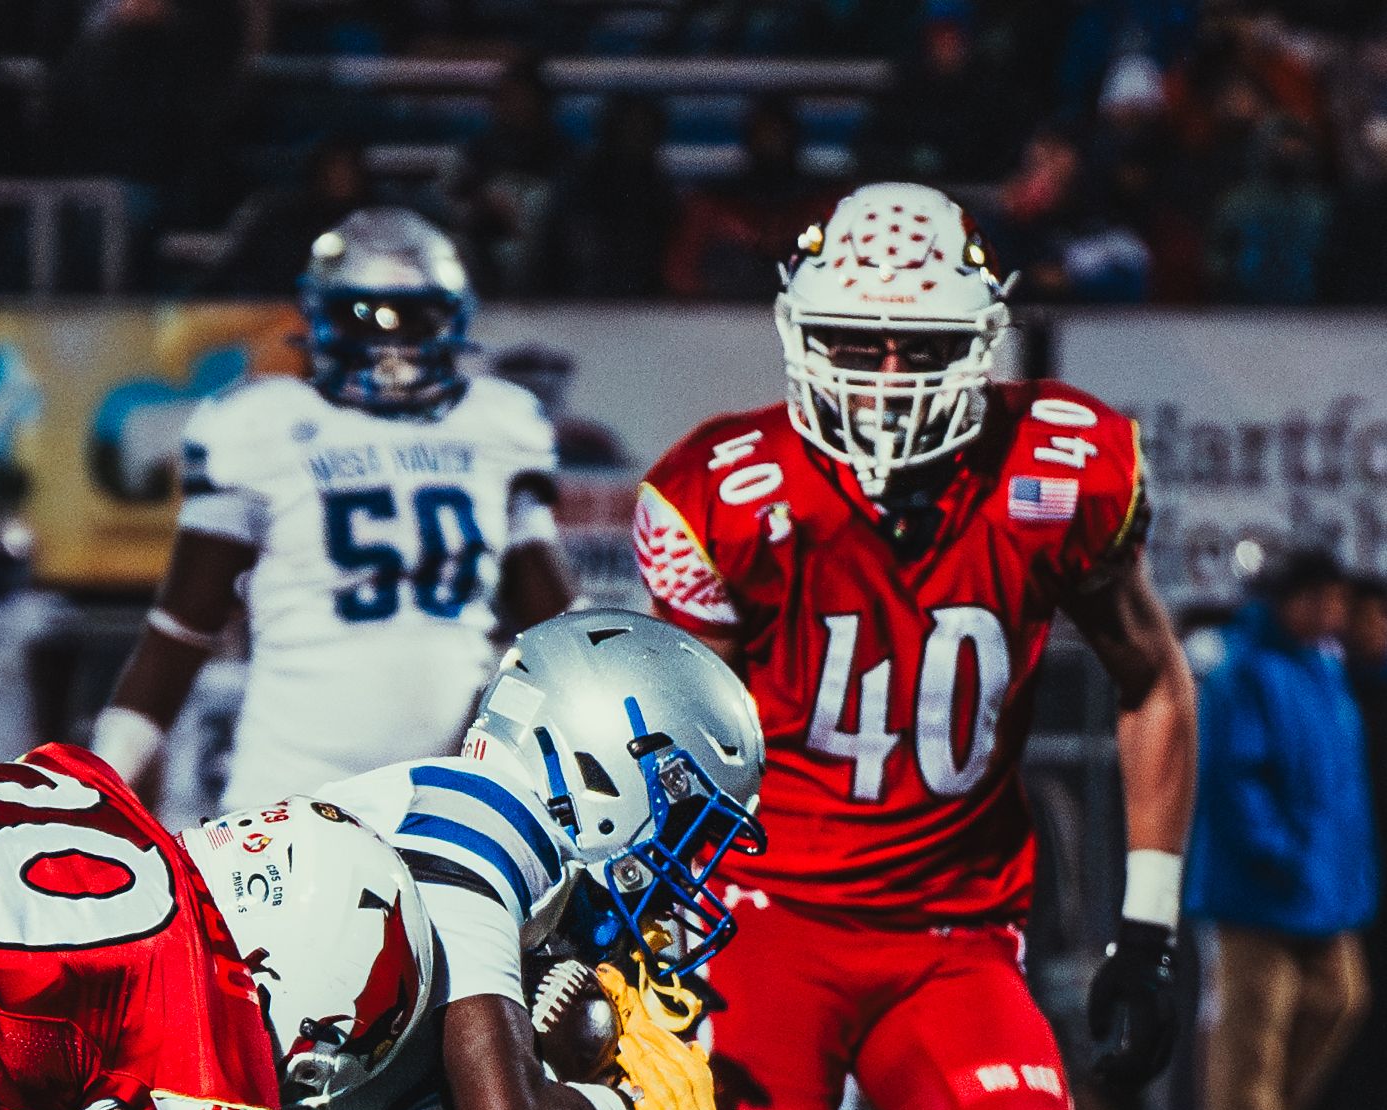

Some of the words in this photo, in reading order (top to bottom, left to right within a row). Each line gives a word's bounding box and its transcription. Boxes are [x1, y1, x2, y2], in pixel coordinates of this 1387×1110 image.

[708, 429, 784, 506] 40
[1030, 399, 1098, 469] 40
[321, 485, 486, 622] 50
[805, 605, 1011, 801] 40
[232, 871, 247, 913] CRUSHS
